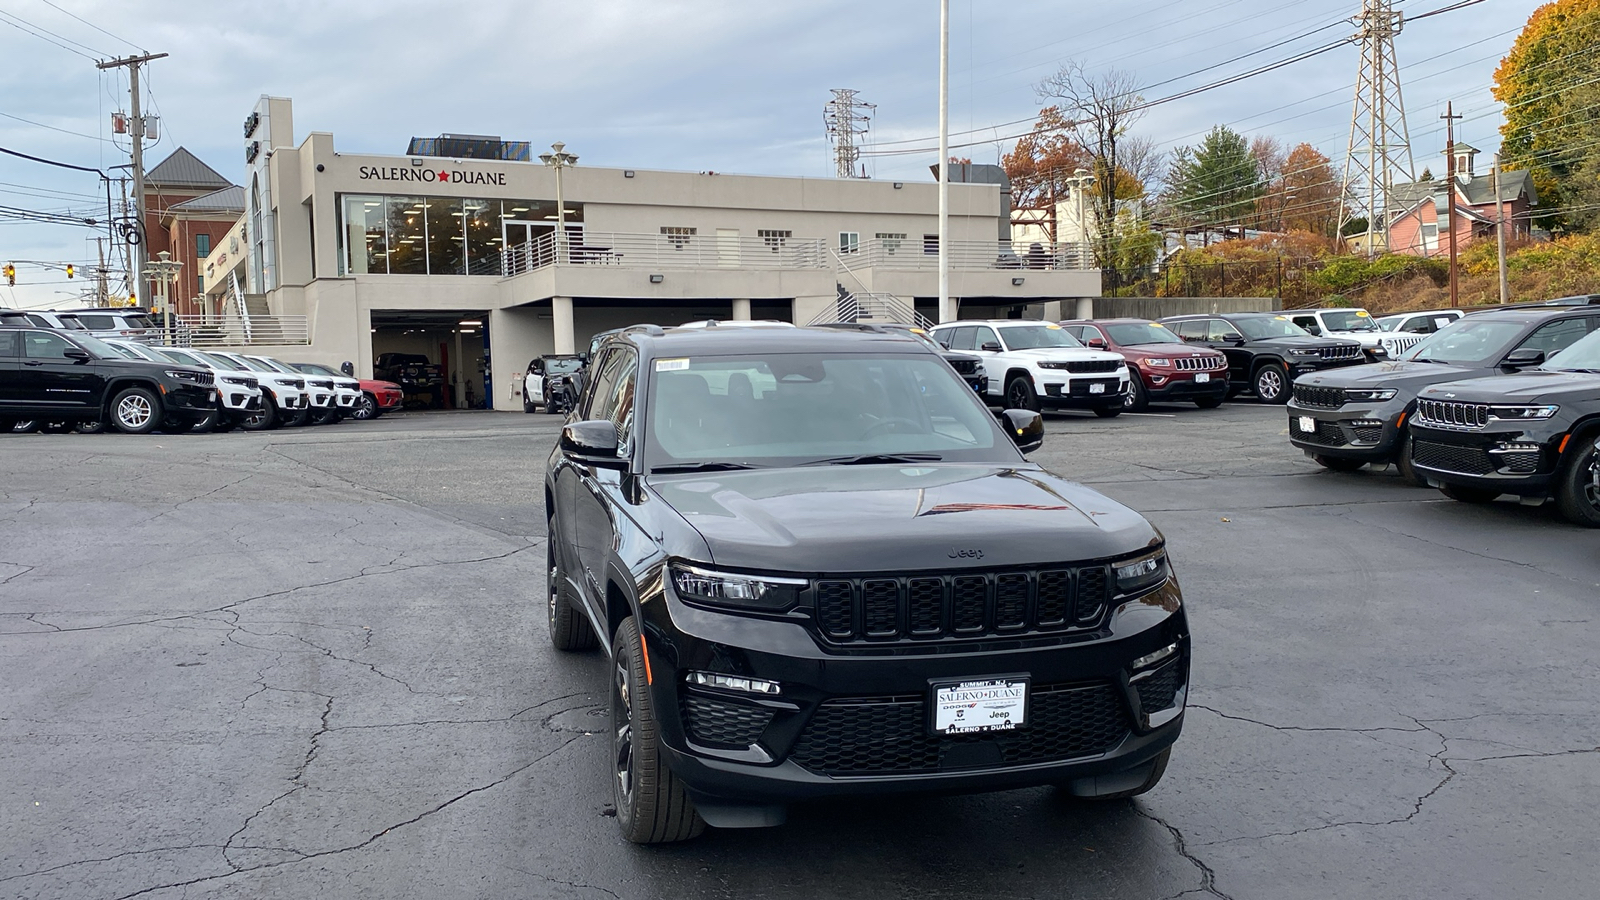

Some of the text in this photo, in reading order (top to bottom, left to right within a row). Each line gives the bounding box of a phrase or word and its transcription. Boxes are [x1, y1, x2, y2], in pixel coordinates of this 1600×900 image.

[359, 166, 507, 186] SALERNO DUANE
[947, 546, 985, 560] Jeep
[939, 688, 1022, 702] SALERNO DUANE
[989, 711, 1010, 719] Jeep
[945, 723, 1016, 735] SALERNO DUANE
